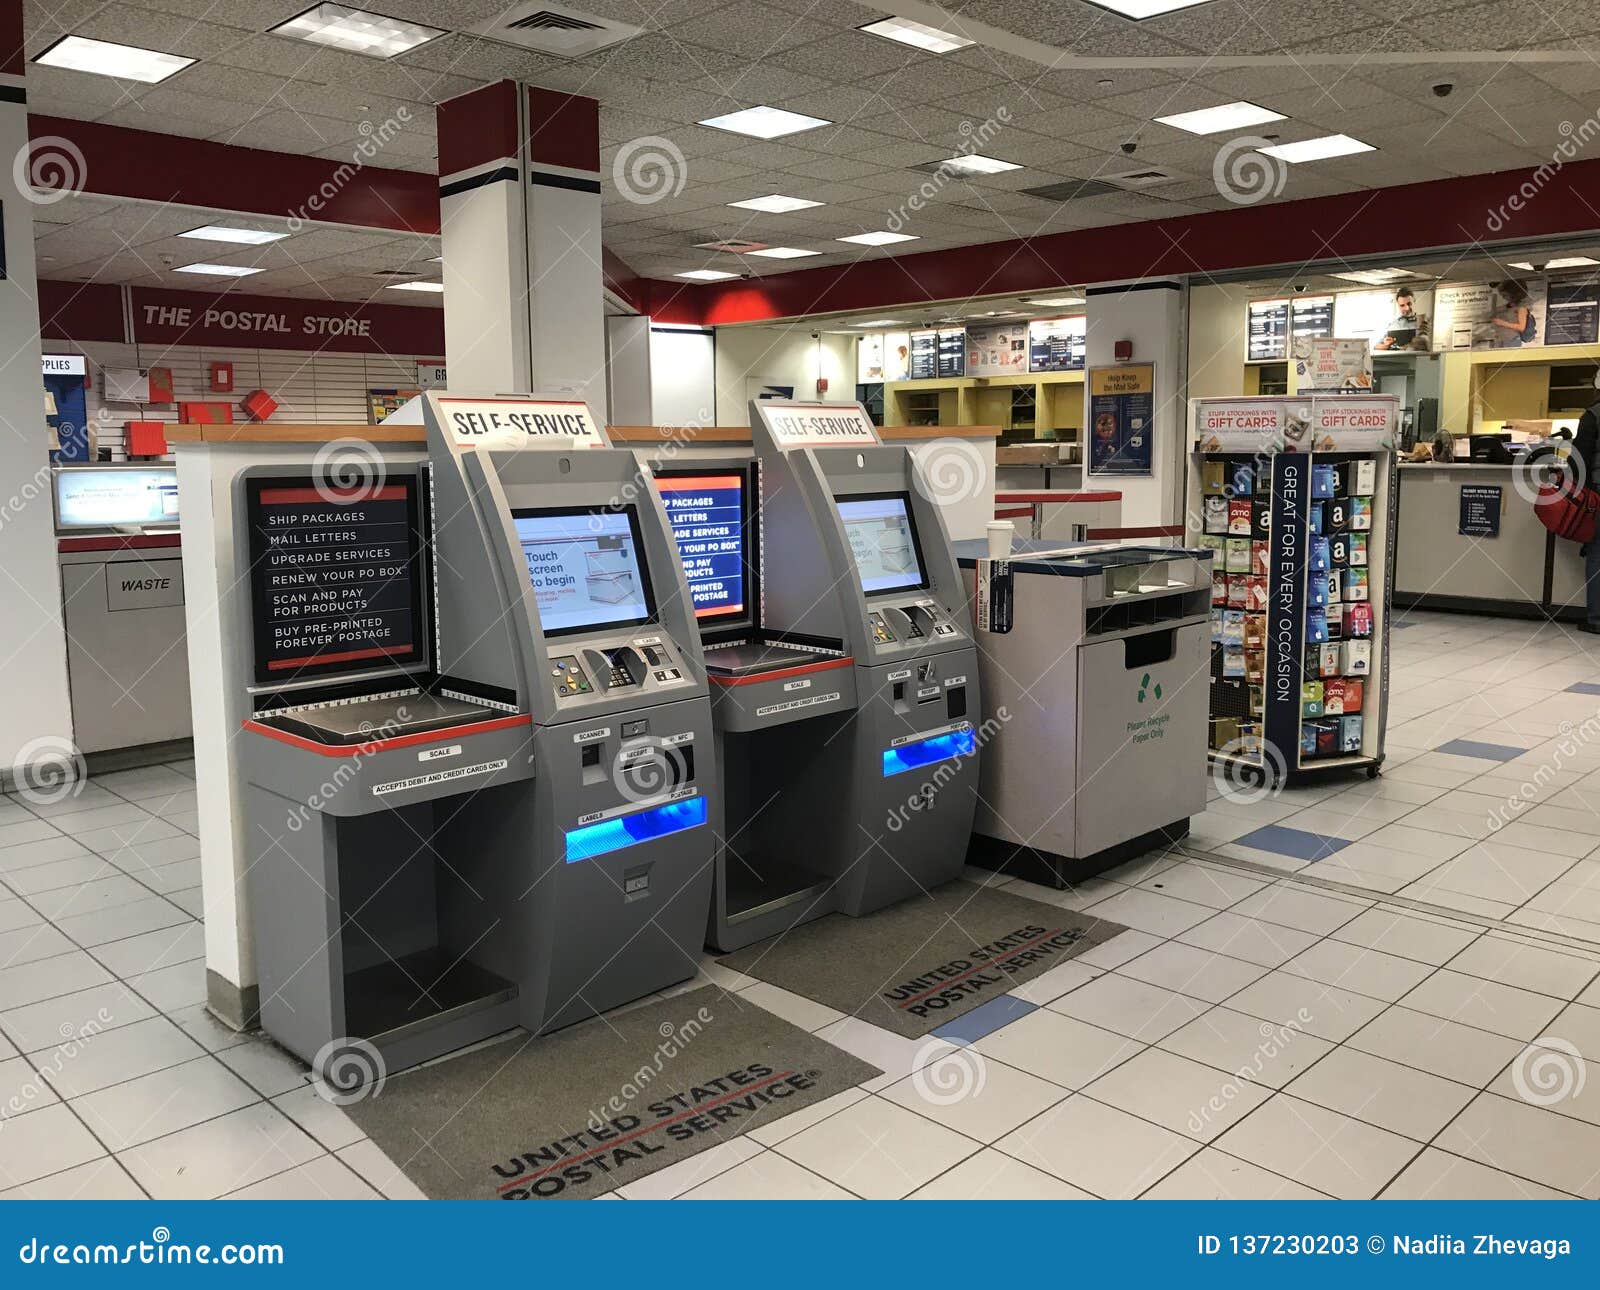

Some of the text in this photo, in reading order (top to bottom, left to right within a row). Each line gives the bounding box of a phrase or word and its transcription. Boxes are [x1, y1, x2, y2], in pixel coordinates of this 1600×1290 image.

[143, 305, 371, 337] THE POSTAL STORE
[41, 360, 70, 371] PPLIES
[1121, 373, 1137, 382] Keep
[453, 412, 591, 435] SELF-SERVICE
[775, 417, 867, 436] SELF-SERVICE
[1208, 416, 1277, 428] GIFT CARDS
[1321, 415, 1386, 427] GIFT CARDS
[672, 497, 713, 507] PACKAGES
[269, 512, 365, 525] SHIP PACKAGES
[674, 513, 708, 523] LETTERS
[1333, 506, 1343, 523] a
[270, 532, 357, 545] MAIL LETTERS
[692, 527, 729, 537] SERVICES
[684, 543, 706, 552] YOUR
[707, 542, 719, 551] PO
[1333, 541, 1345, 559] a
[271, 549, 391, 565] UPGRADE SERVICES
[526, 551, 558, 562] Touch
[682, 558, 711, 568] ND PAY
[528, 564, 563, 575] screen
[685, 567, 713, 577] DUCTS
[272, 573, 317, 585] RENEW
[322, 570, 355, 581] YOUR
[359, 568, 375, 578] PO
[531, 574, 575, 587] to begin
[121, 578, 171, 592] WASTE
[690, 582, 723, 593] PRINTED
[1277, 466, 1297, 701] GREAT FOR EVERY OCCASION
[1328, 578, 1336, 594] a
[273, 588, 364, 605] SCAN AND PAY
[694, 591, 728, 602] POSTAGE
[274, 600, 367, 617] FOR PRODUCTS
[275, 617, 383, 637] BUY PRE-PRINTED
[339, 628, 391, 642] POSTAGE
[579, 730, 605, 740] SCANNER
[430, 748, 450, 758] SCALE
[376, 761, 504, 793] ACCEPTS DEBIT AND CREDIT CARDS ONLY
[582, 812, 603, 823] LABELS
[884, 924, 1047, 1002] UNITED STATES
[907, 973, 1002, 1018] POSTAL
[492, 1063, 773, 1179] UNITED STATES
[502, 1138, 665, 1200] POSTAL
